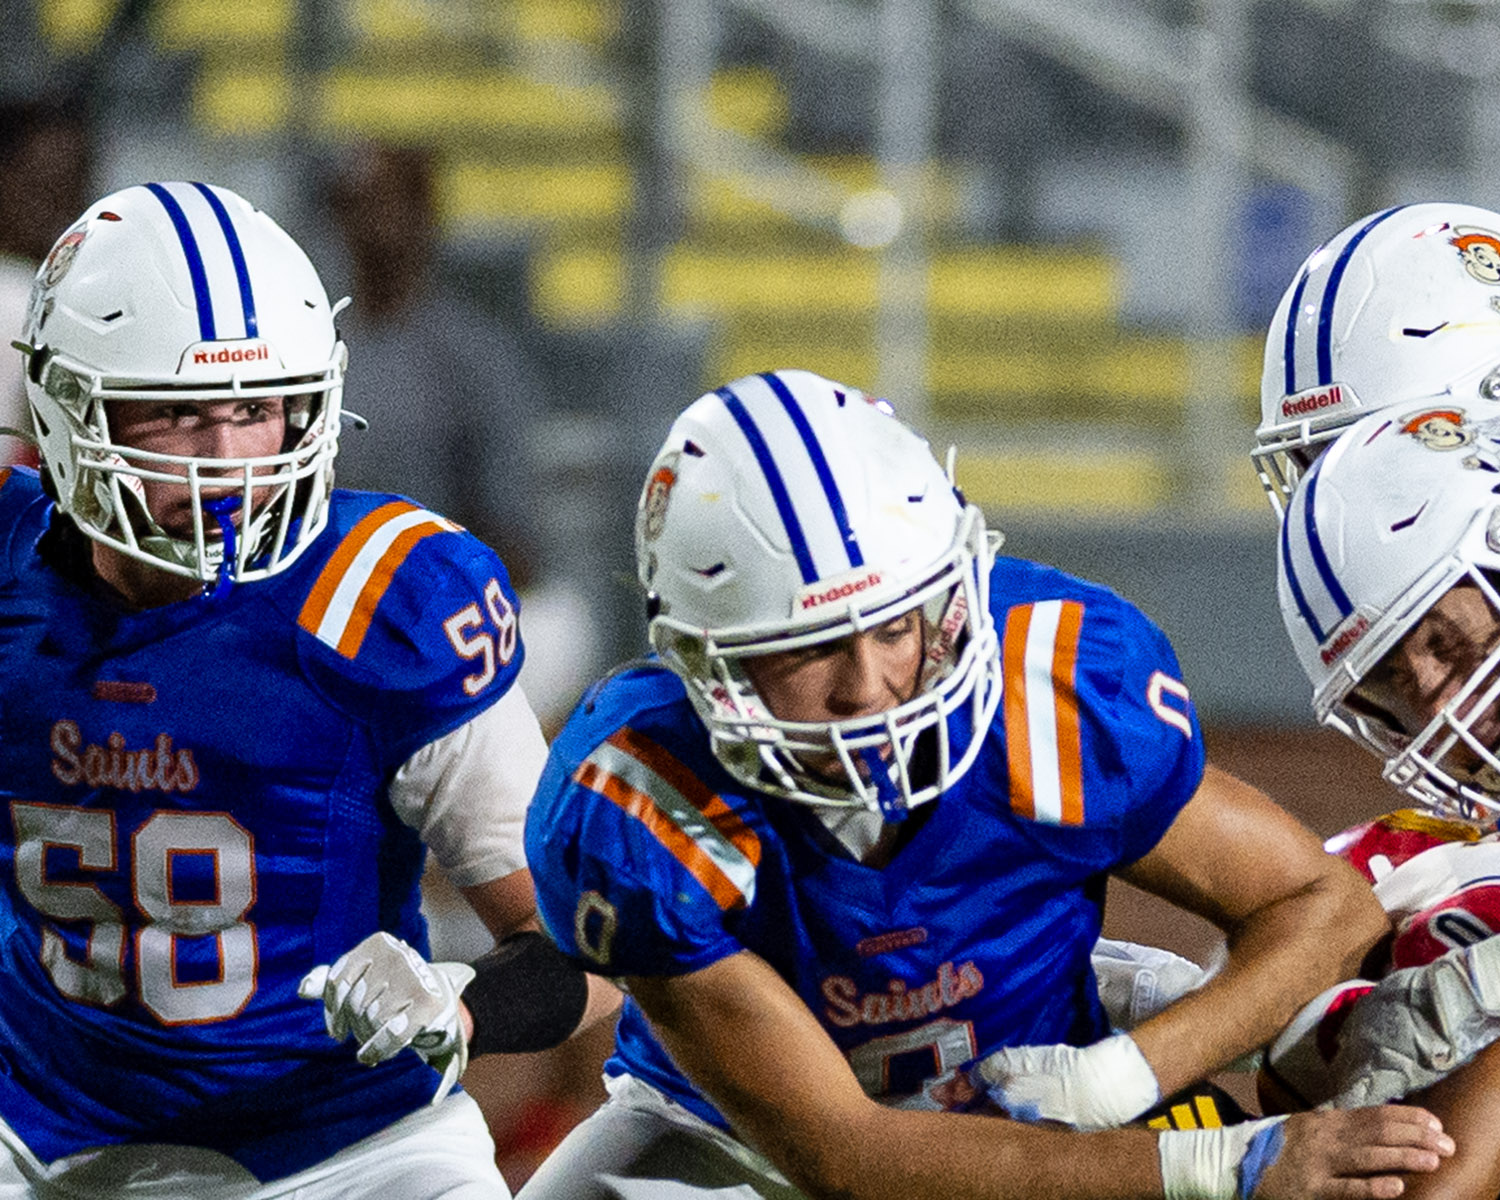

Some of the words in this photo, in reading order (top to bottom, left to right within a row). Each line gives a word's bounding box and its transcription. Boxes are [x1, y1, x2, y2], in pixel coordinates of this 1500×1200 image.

[193, 344, 269, 365] Riddell
[1281, 385, 1341, 417] Riddell
[442, 577, 517, 696] 58
[51, 718, 200, 793] Saints
[9, 798, 260, 1028] 58
[573, 889, 619, 966] 0
[820, 960, 985, 1029] Saints
